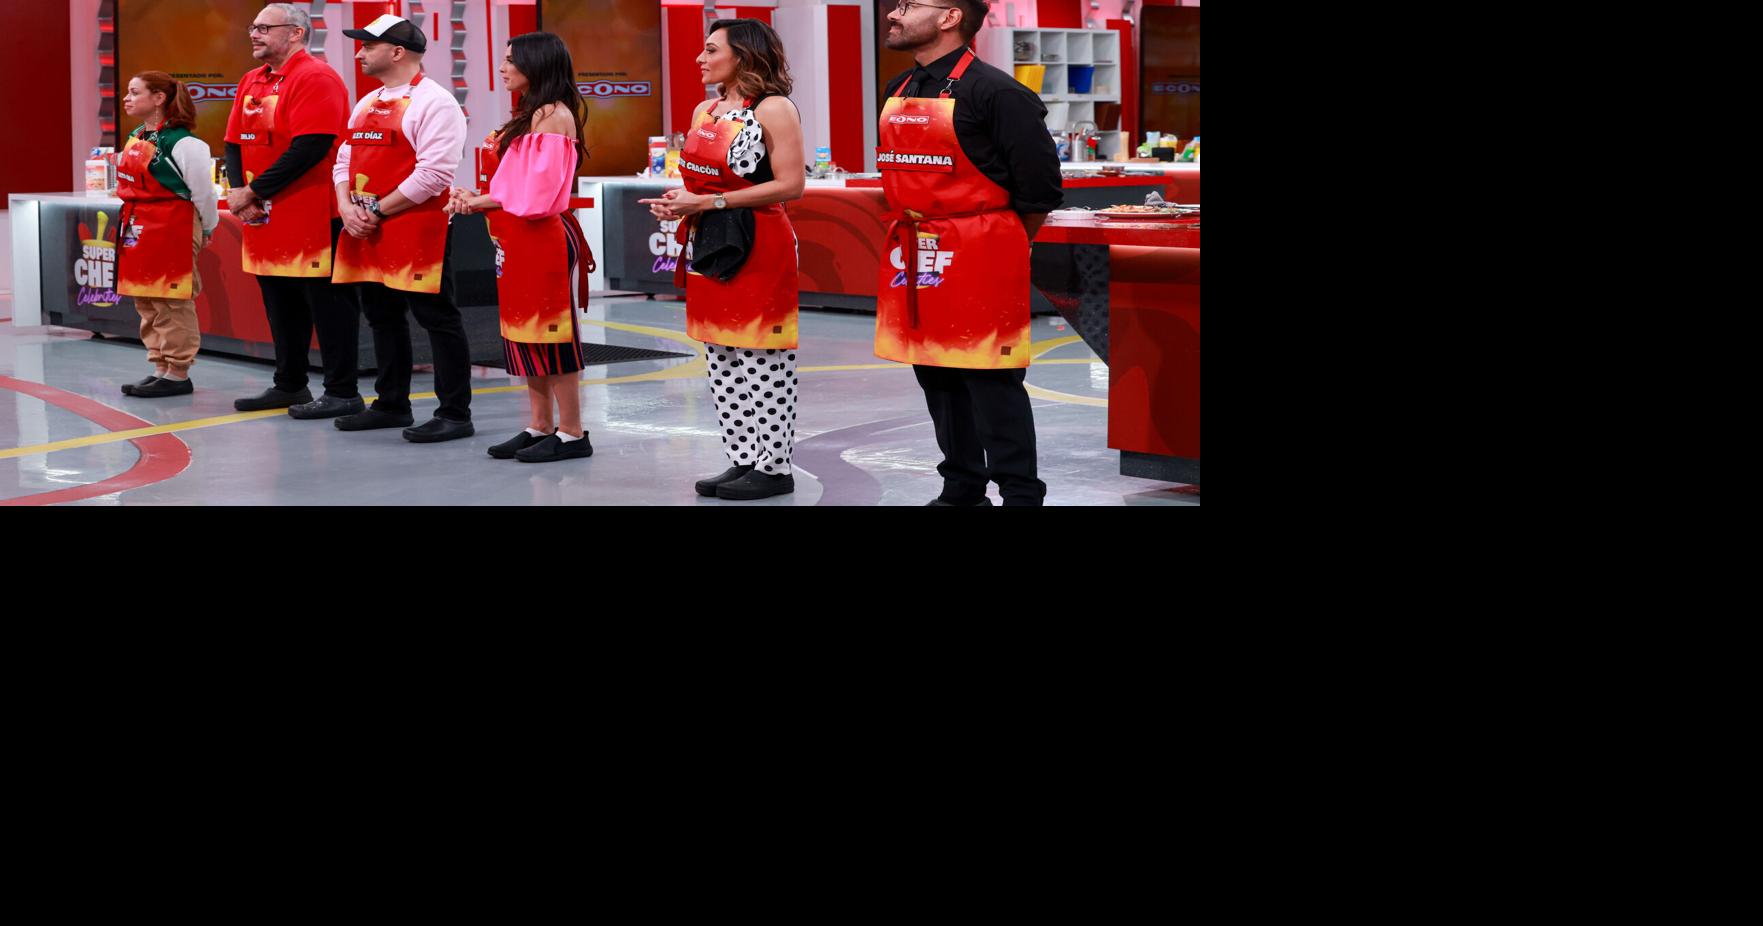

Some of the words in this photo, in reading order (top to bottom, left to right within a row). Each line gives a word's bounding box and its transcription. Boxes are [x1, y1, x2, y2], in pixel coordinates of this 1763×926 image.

[577, 83, 648, 95] CONO
[365, 131, 383, 139] DÍAZ
[877, 150, 894, 163] JOSÉ
[895, 153, 953, 166] SANTANA
[82, 244, 115, 260] SUPER
[890, 246, 954, 274] CEF
[74, 258, 115, 288] CHE
